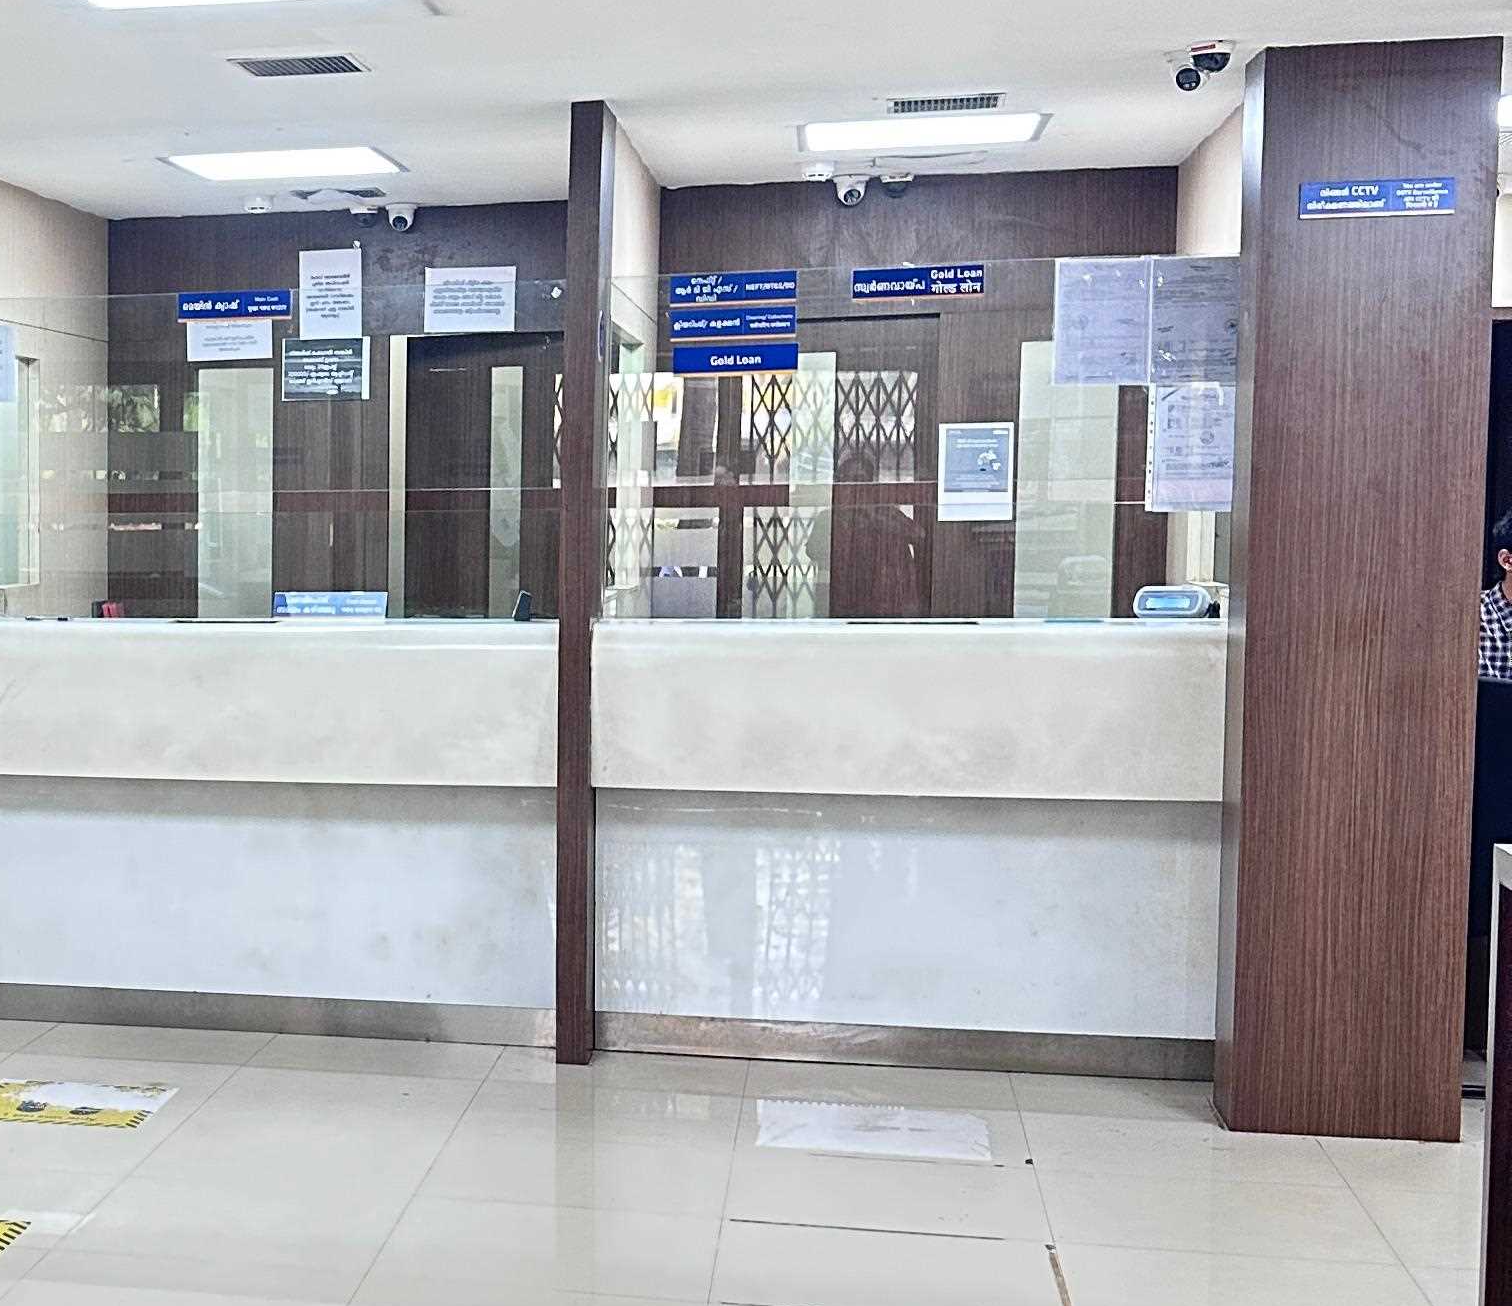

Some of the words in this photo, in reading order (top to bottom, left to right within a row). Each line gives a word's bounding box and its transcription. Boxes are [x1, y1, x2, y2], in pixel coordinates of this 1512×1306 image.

[1351, 185, 1379, 196] CCTV
[930, 269, 955, 280] Gold
[957, 268, 983, 278] Loan
[959, 279, 982, 293] लोन
[710, 355, 734, 366] Gold
[736, 355, 762, 365] Loan
